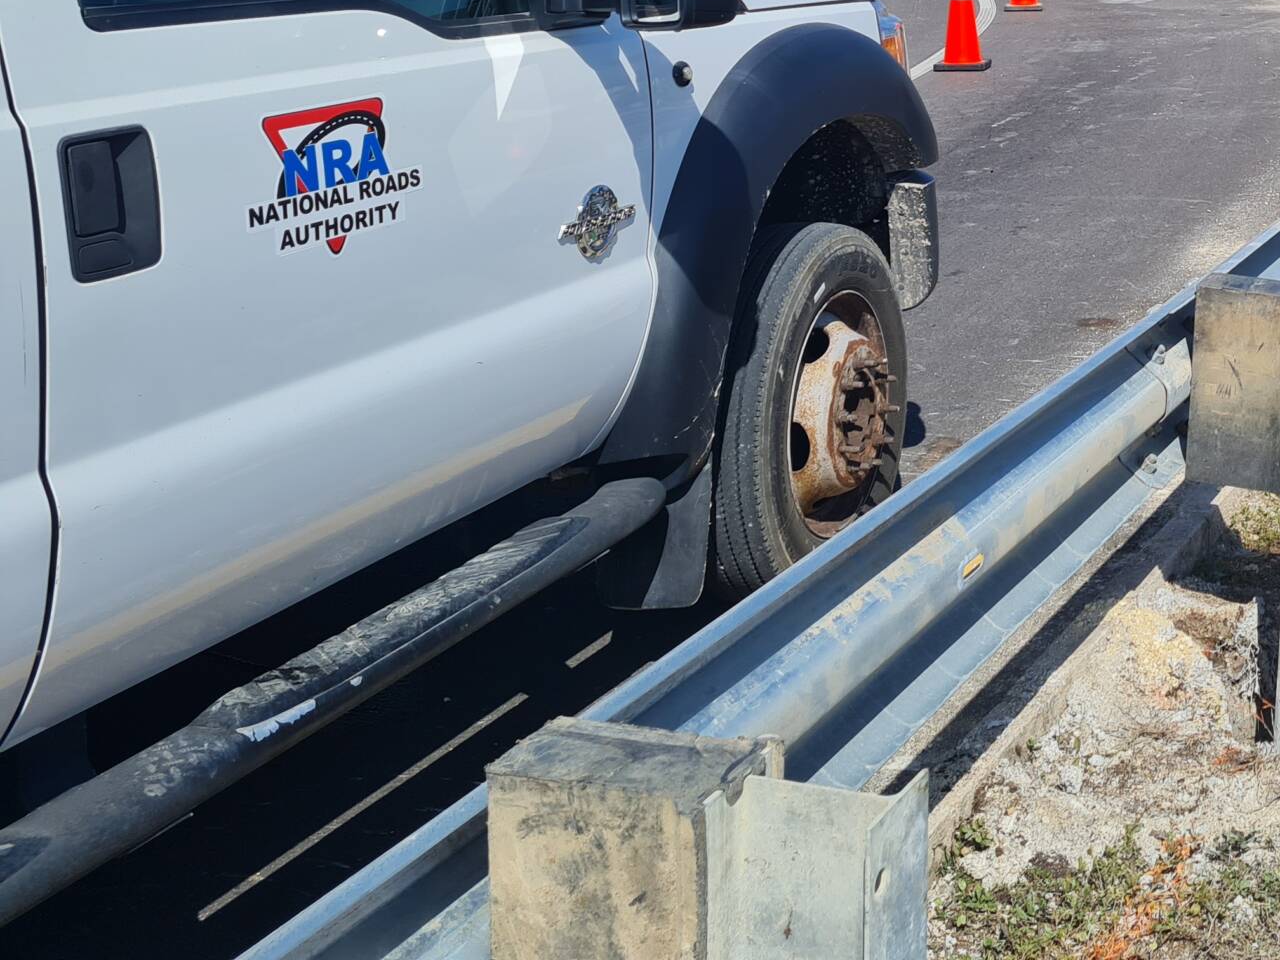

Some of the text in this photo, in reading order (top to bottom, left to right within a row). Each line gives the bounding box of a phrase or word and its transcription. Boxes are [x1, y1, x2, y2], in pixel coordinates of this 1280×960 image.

[281, 132, 390, 198] NRA
[248, 169, 421, 228] NATIONAL ROADS
[280, 201, 400, 251] AUTHORITY
